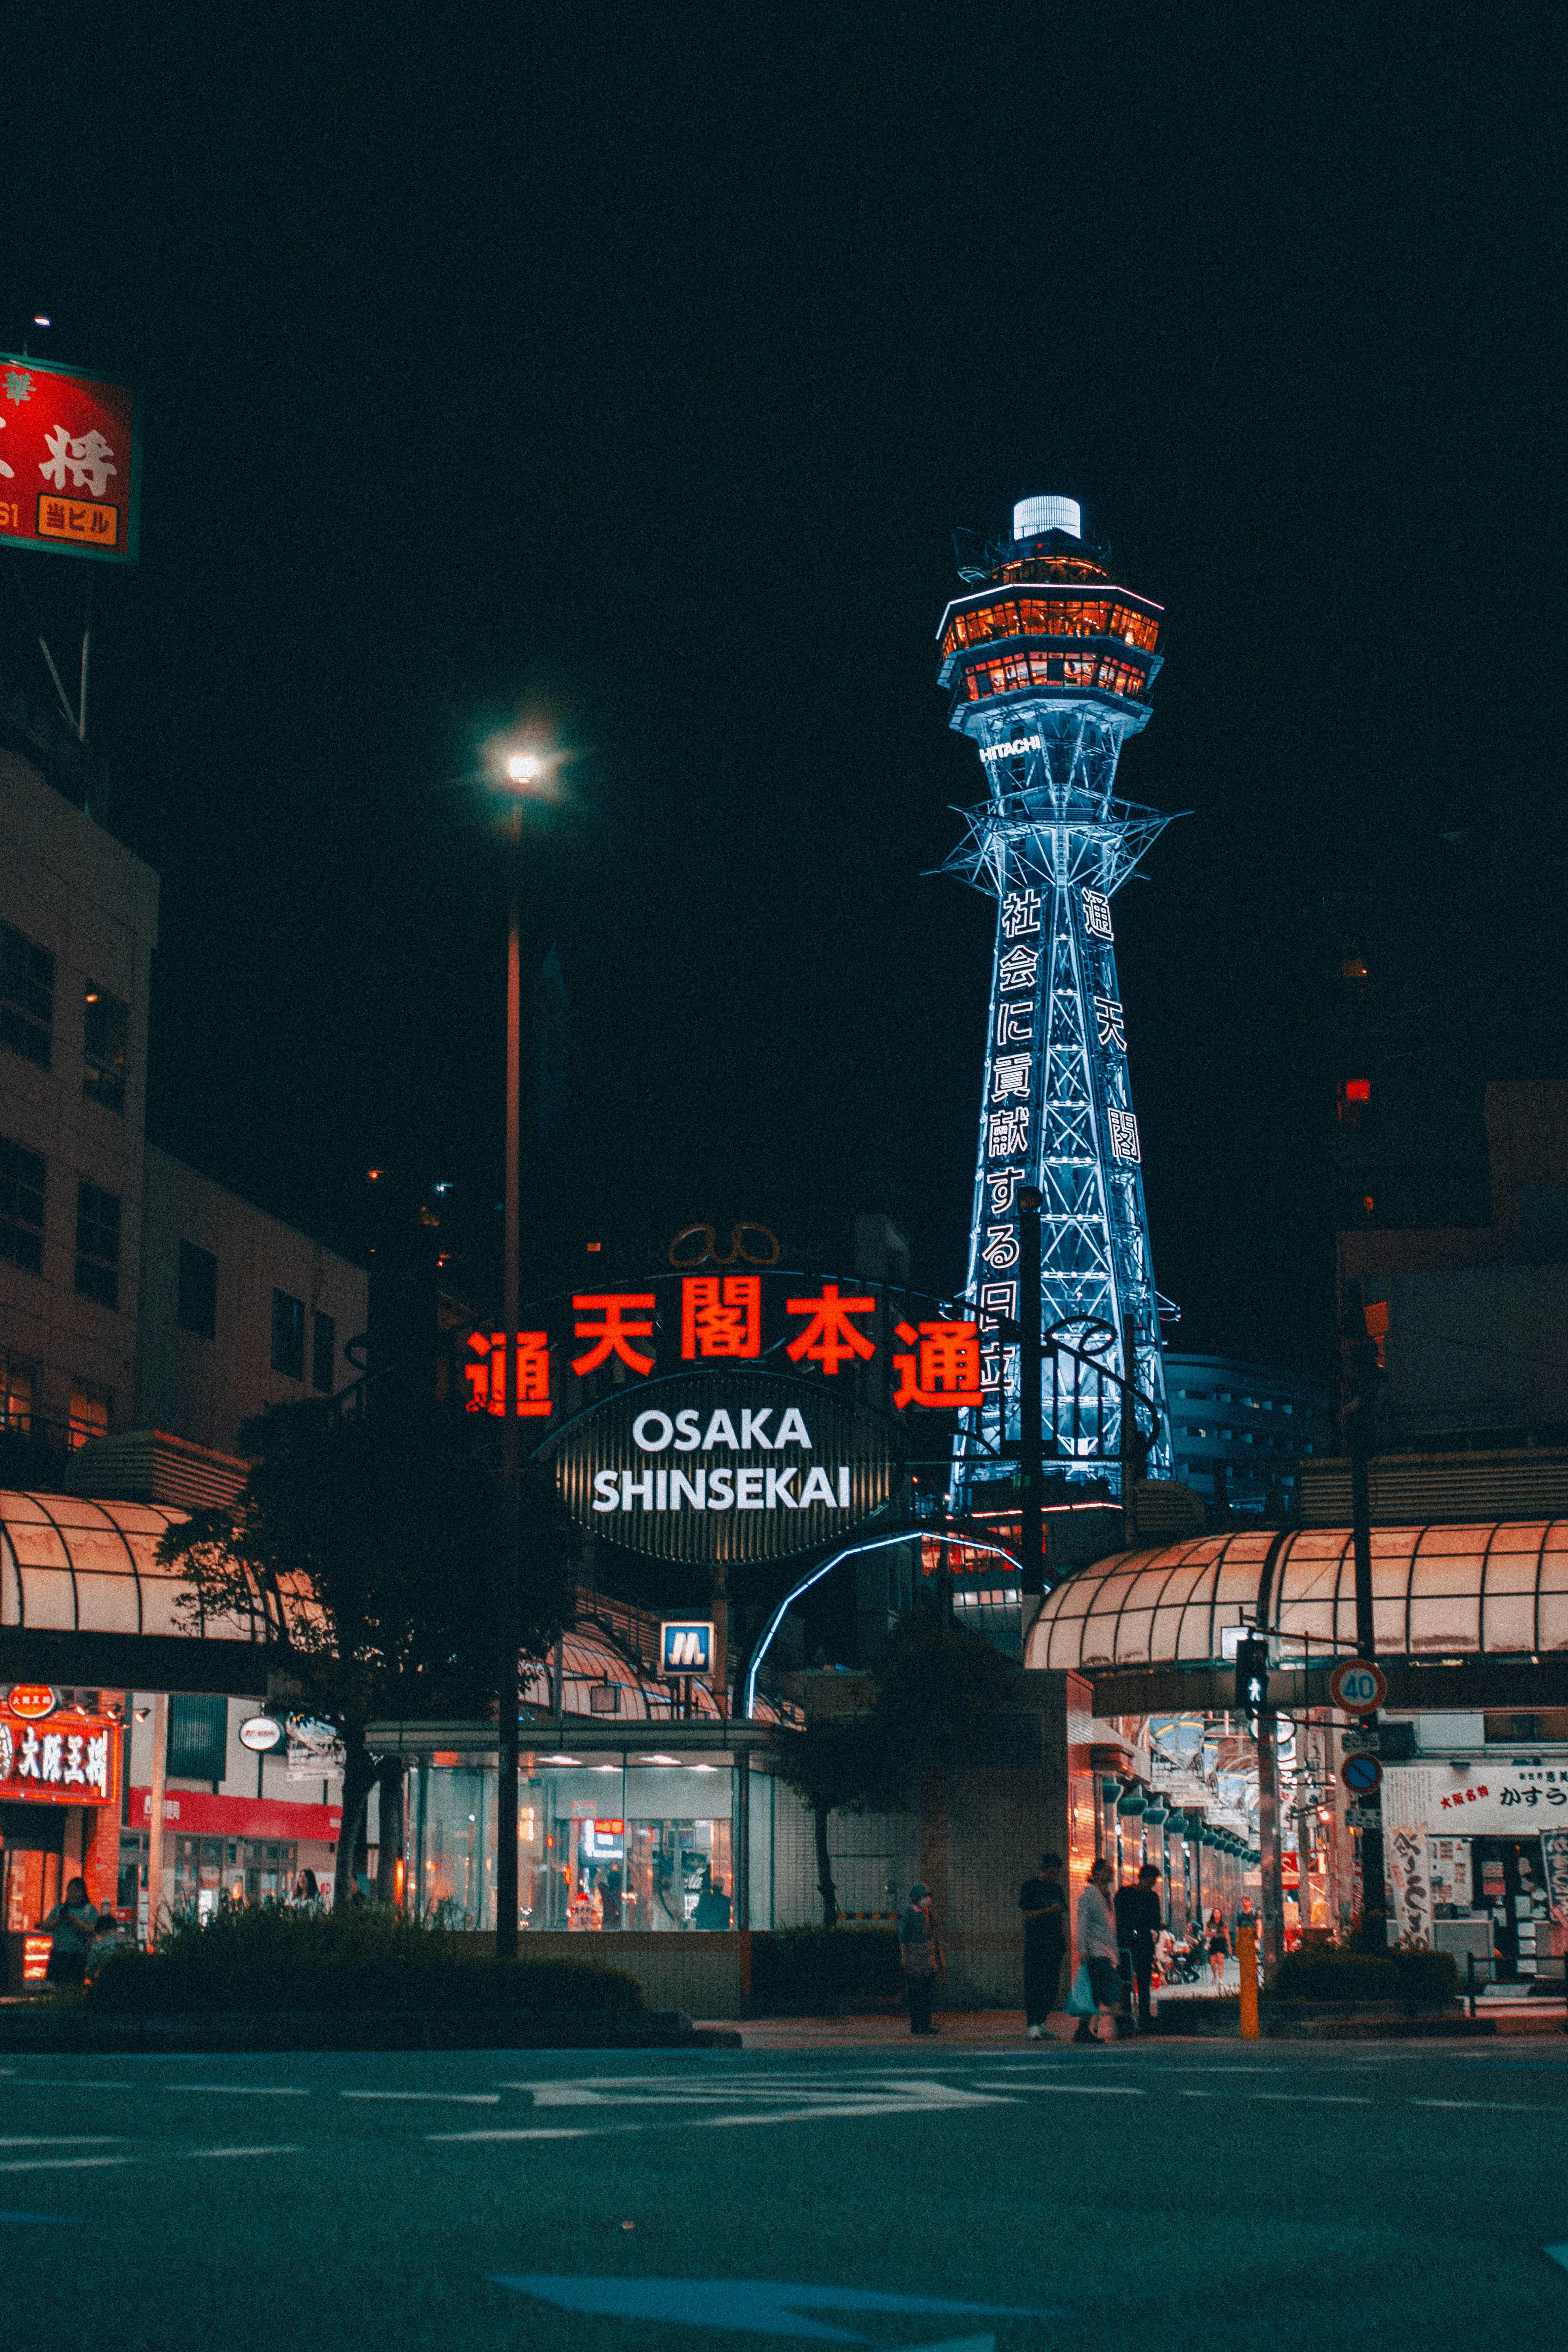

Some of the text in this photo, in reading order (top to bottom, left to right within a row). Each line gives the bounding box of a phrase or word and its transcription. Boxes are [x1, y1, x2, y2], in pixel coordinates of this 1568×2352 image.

[2, 371, 37, 406] 華
[46, 503, 109, 534] 当ビル
[979, 735, 1041, 762] HITACHI
[1081, 887, 1141, 1164] 通天閣
[632, 1407, 812, 1452] OSAKA
[592, 1466, 850, 1512] SHINSEKAI
[1343, 1674, 1374, 1700] 40
[1499, 1785, 1567, 1807] かすう
